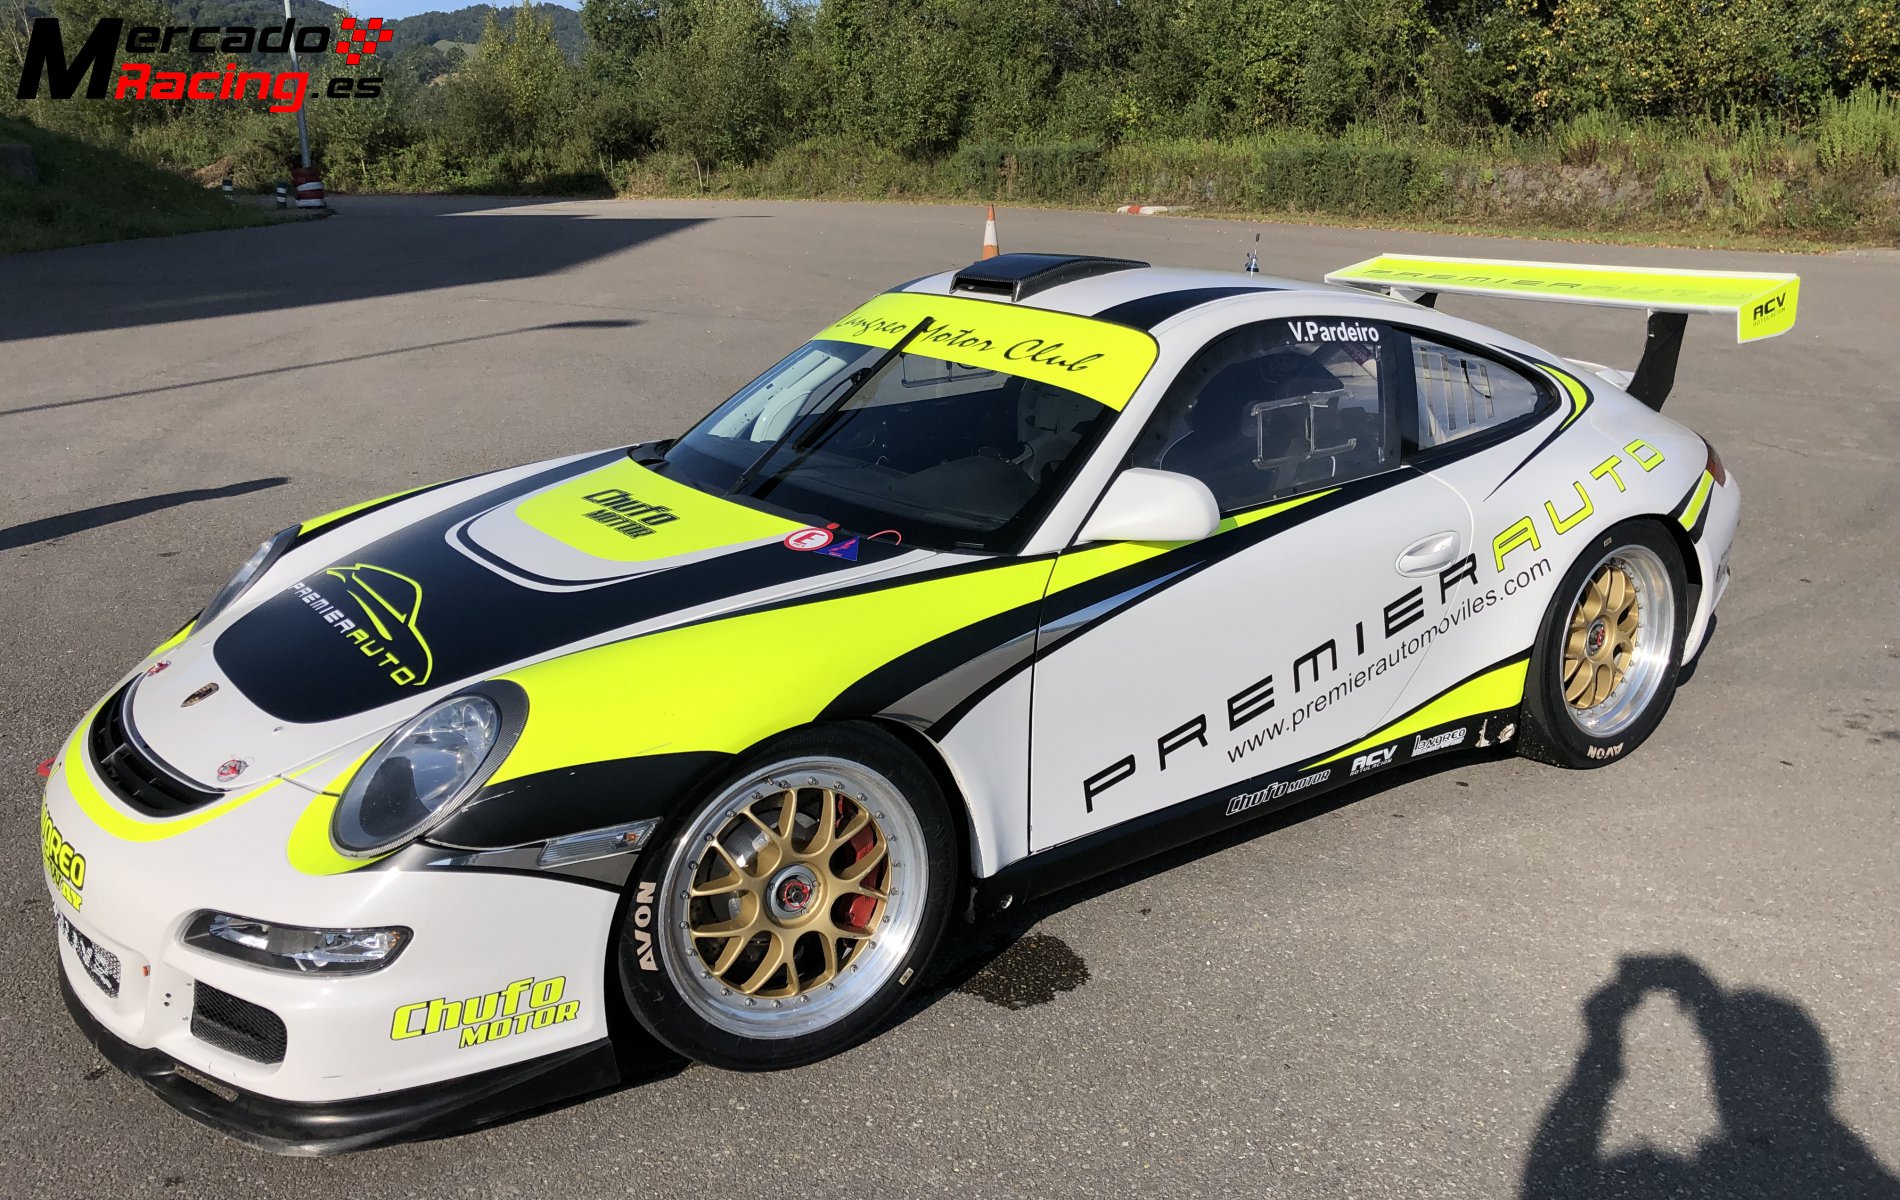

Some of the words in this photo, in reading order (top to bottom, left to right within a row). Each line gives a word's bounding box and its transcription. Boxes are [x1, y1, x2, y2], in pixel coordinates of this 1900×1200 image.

[1753, 291, 1787, 321] ACV
[1288, 321, 1380, 343] V.Pardeiro
[1002, 338, 1105, 372] Club
[581, 507, 657, 540] MOTOR
[1227, 556, 1552, 764] www.premierautomoviles.com
[1351, 744, 1398, 772] ACV
[1586, 741, 1624, 760] AVON
[634, 881, 659, 972] AVON
[390, 976, 567, 1041] Chufo
[458, 1000, 581, 1049] MOTOR
